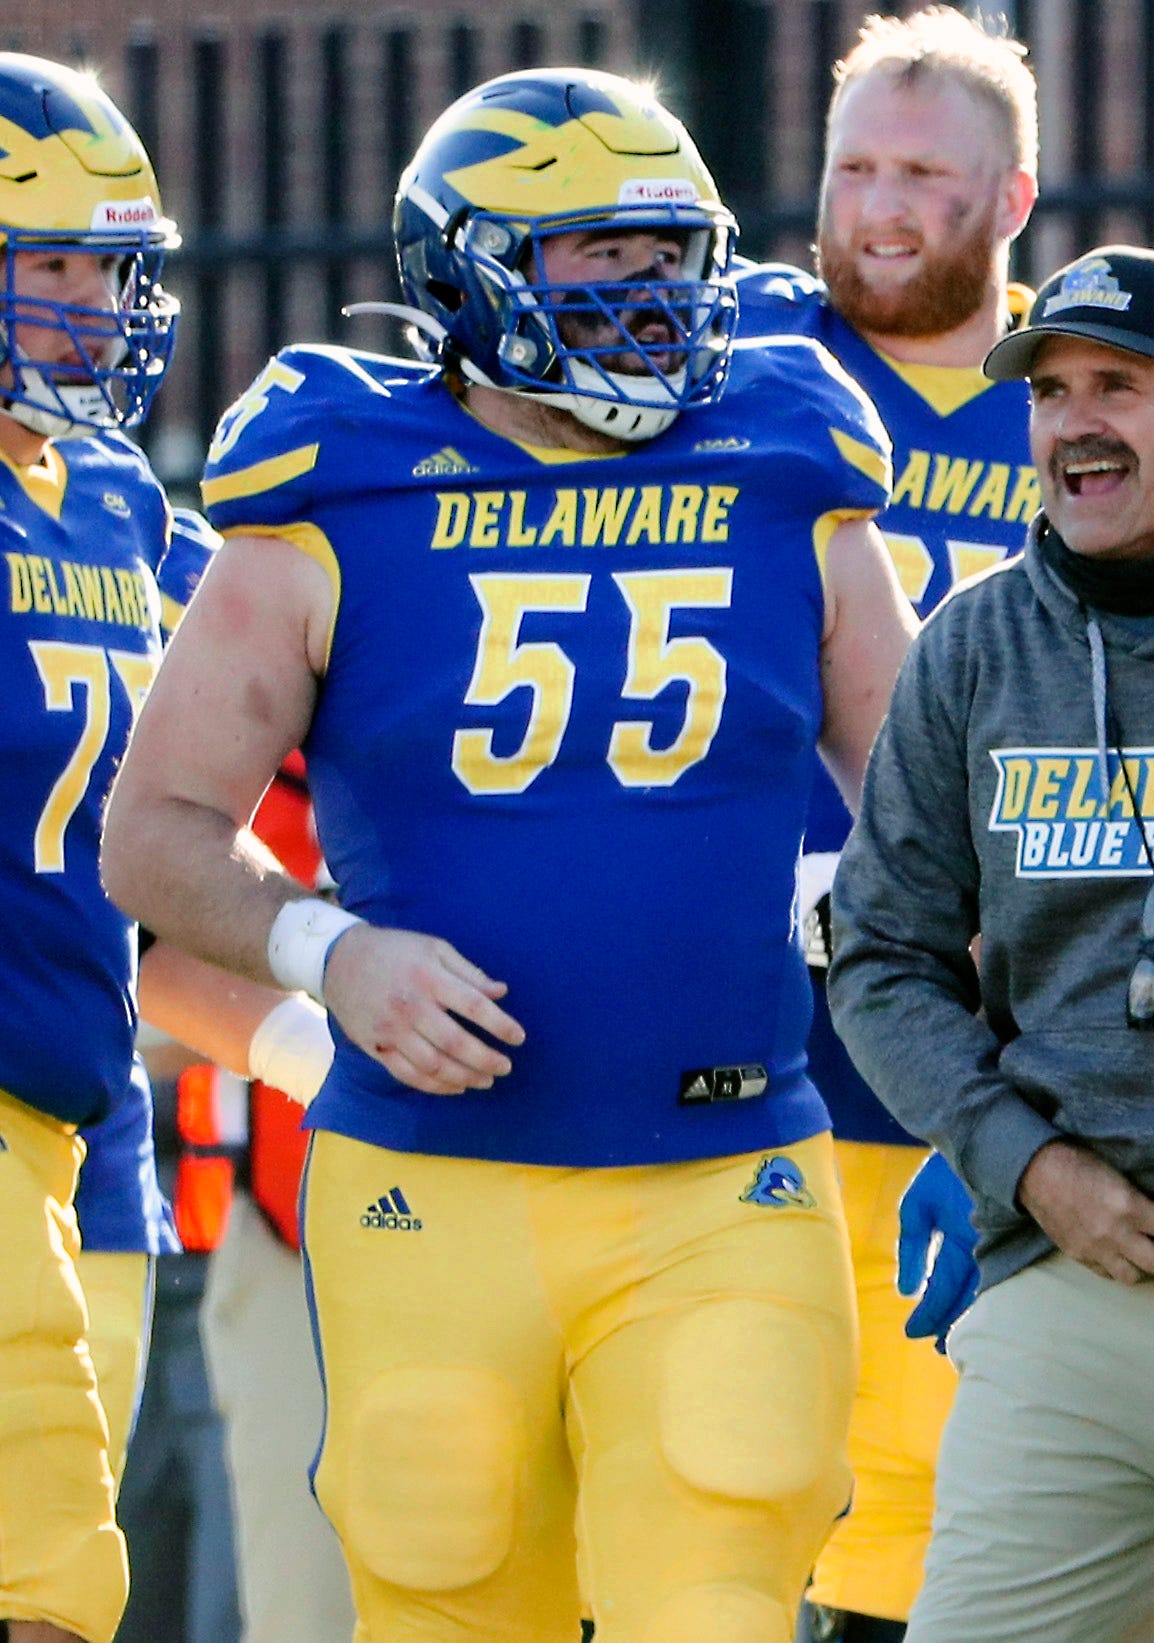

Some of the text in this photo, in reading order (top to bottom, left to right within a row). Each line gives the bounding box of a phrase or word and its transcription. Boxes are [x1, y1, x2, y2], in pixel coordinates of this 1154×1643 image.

[430, 485, 740, 550] DELAWARE
[891, 449, 1042, 524] AWAR
[5, 552, 152, 628] DELAWARE
[452, 567, 734, 795] 55
[1023, 821, 1130, 868] BLUE
[360, 1213, 423, 1231] adidas
